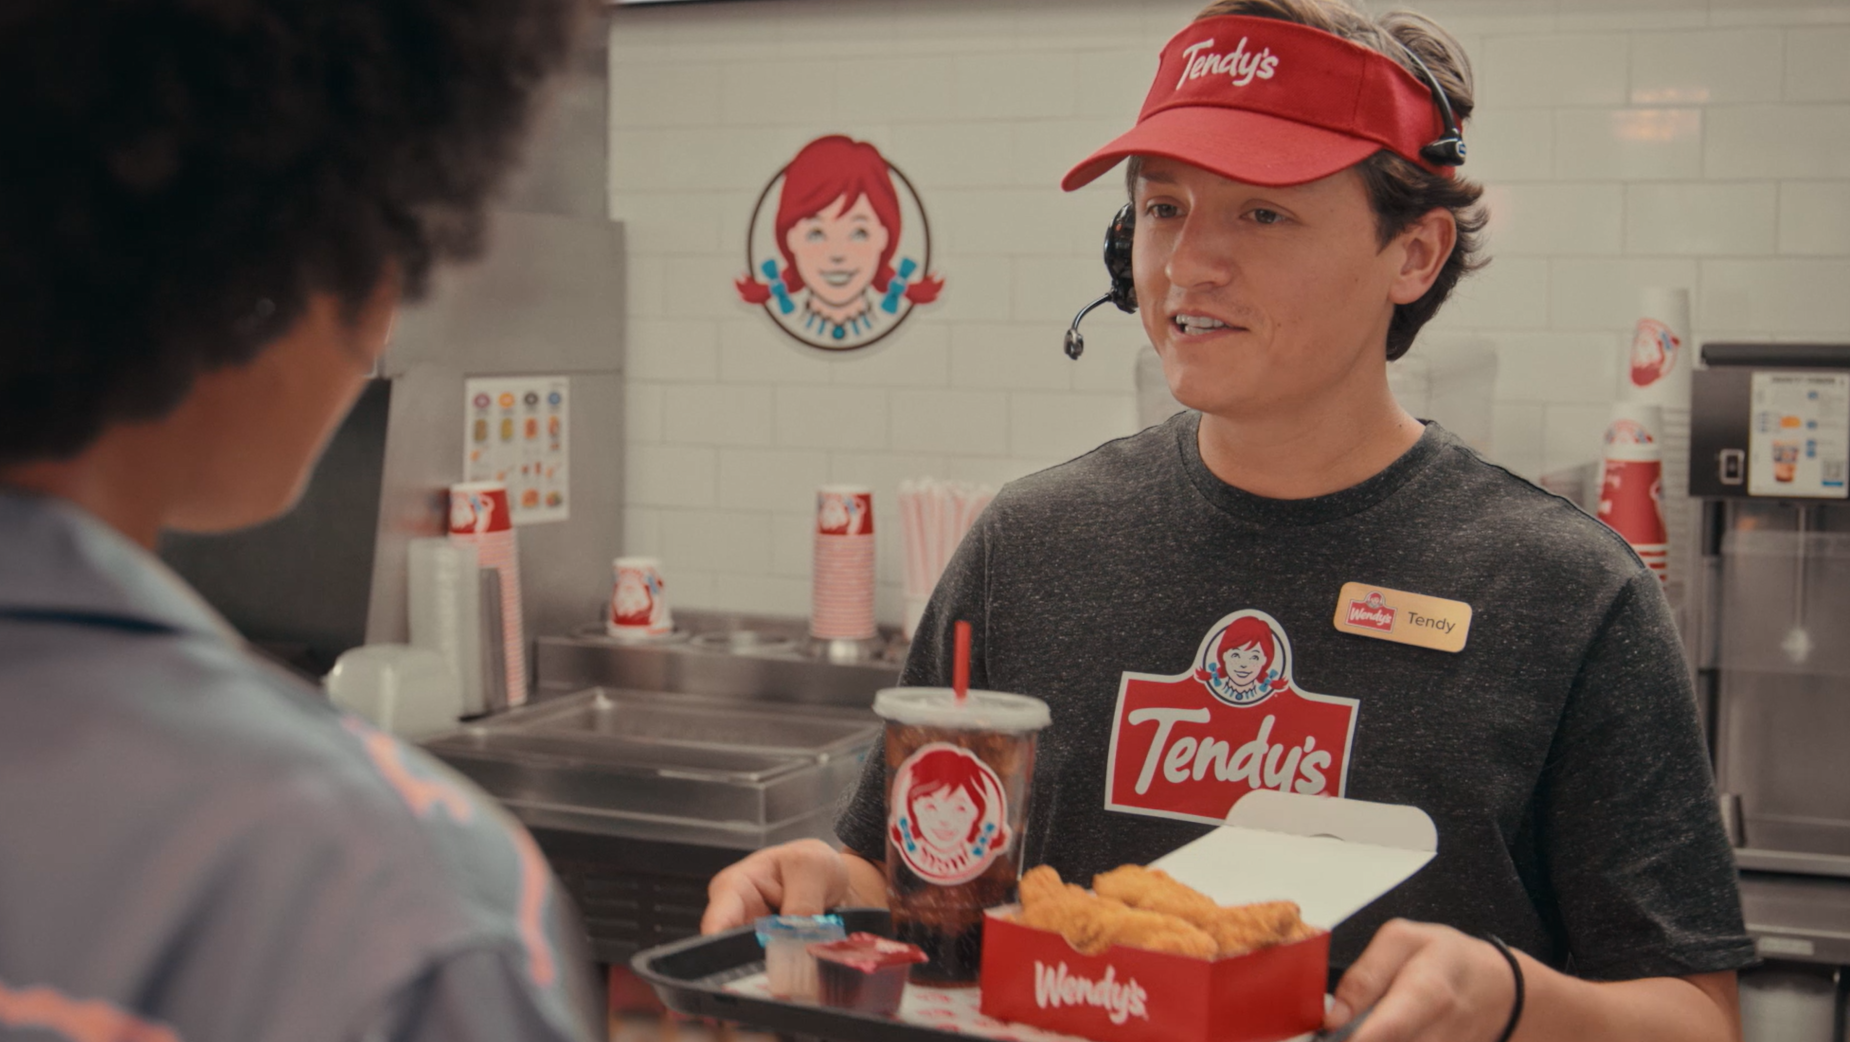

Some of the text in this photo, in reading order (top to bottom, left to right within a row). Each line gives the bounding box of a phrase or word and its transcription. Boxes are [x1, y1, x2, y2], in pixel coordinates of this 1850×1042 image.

[1175, 36, 1279, 90] Tendy's
[1349, 606, 1392, 626] Wendy's
[1408, 611, 1456, 634] Tendy
[1128, 707, 1332, 796] Tendy's
[1034, 959, 1149, 1026] Wendy's
